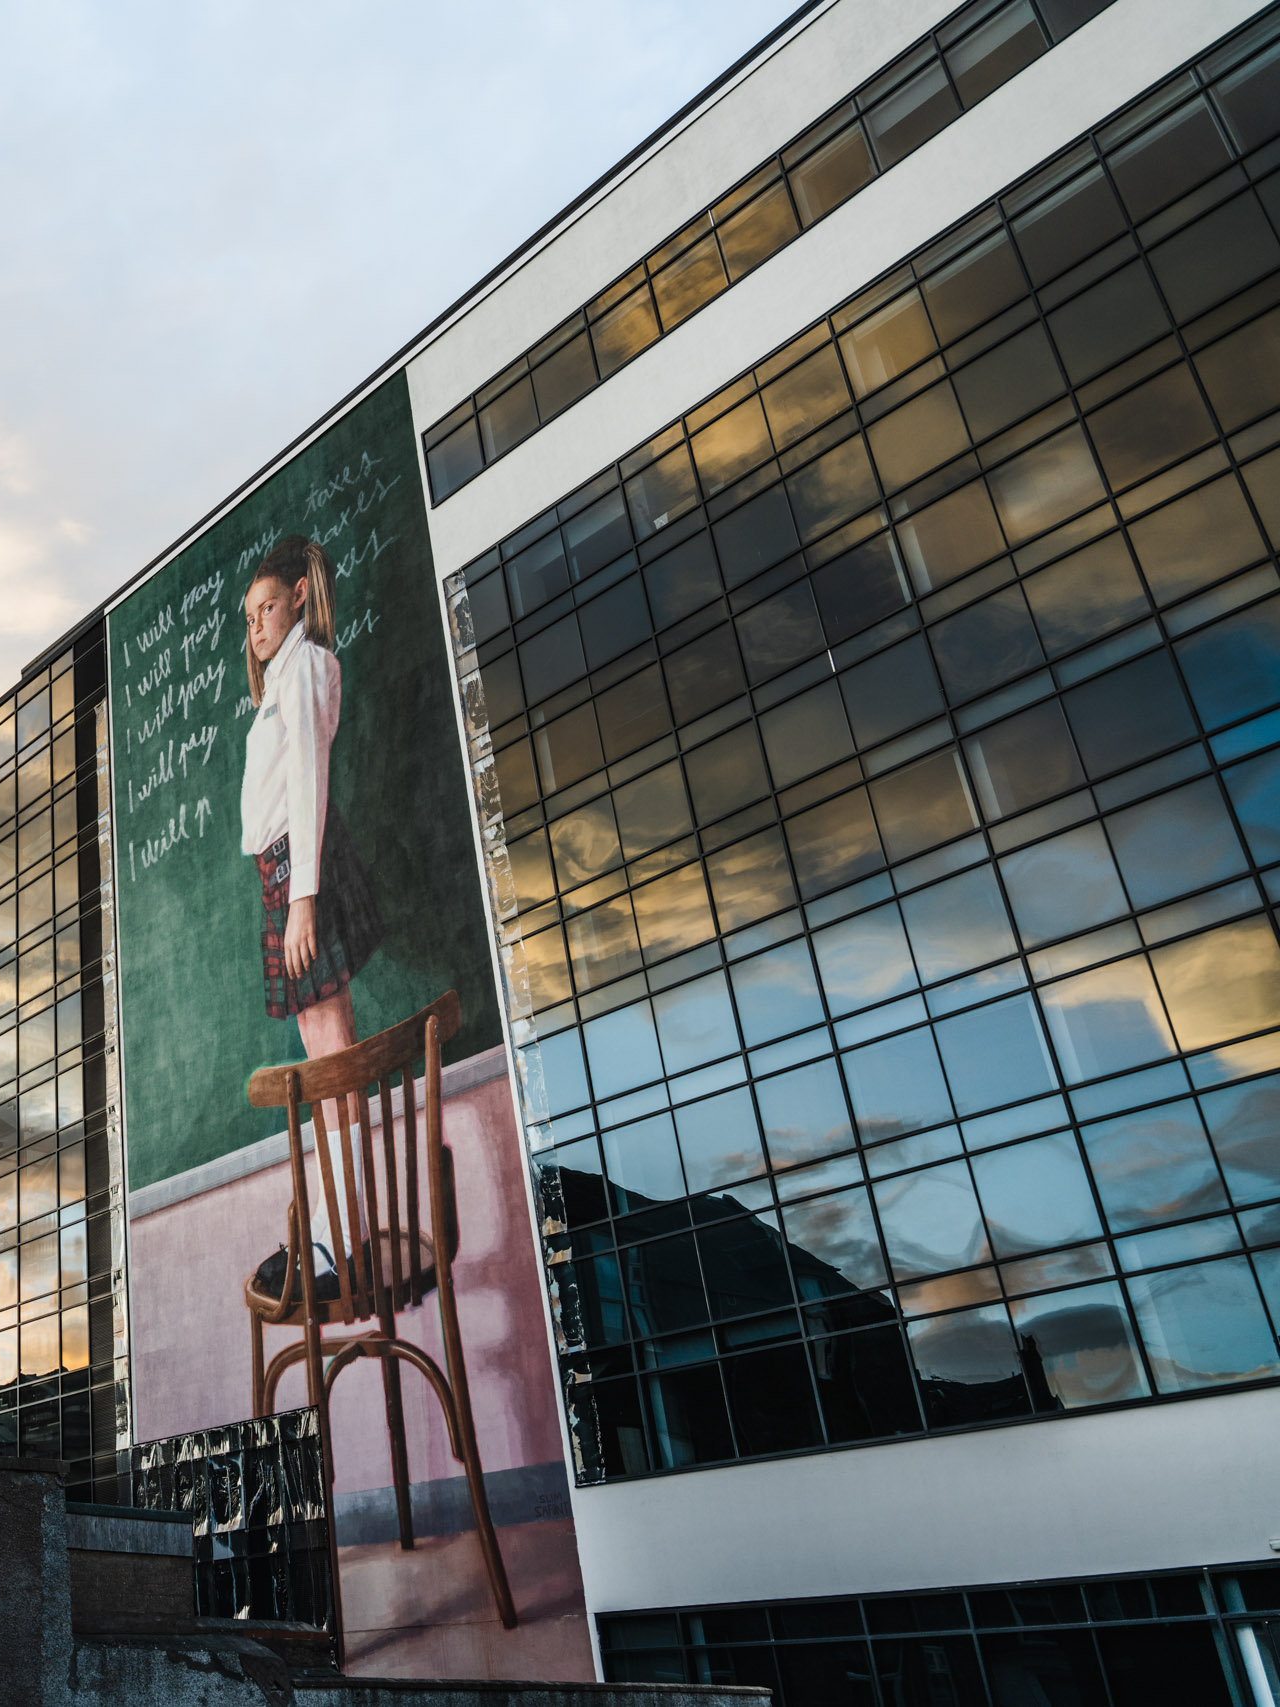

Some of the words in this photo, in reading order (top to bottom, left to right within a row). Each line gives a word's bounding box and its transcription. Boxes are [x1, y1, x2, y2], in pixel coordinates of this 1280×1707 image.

[123, 641, 131, 669] I
[136, 604, 175, 653] will
[180, 570, 225, 626] pay
[236, 526, 282, 574] my
[303, 451, 384, 522] taxes
[125, 684, 131, 708] I
[138, 648, 171, 697] will
[180, 607, 226, 674] pay
[311, 474, 401, 546] taxes
[126, 727, 131, 754] I
[138, 684, 174, 744] will
[177, 658, 226, 720] pay
[336, 528, 401, 580] xes
[128, 779, 134, 814] I
[138, 739, 174, 801] will
[178, 725, 219, 778] pay
[235, 695, 253, 719] m
[129, 840, 136, 882] I
[141, 803, 191, 868] will
